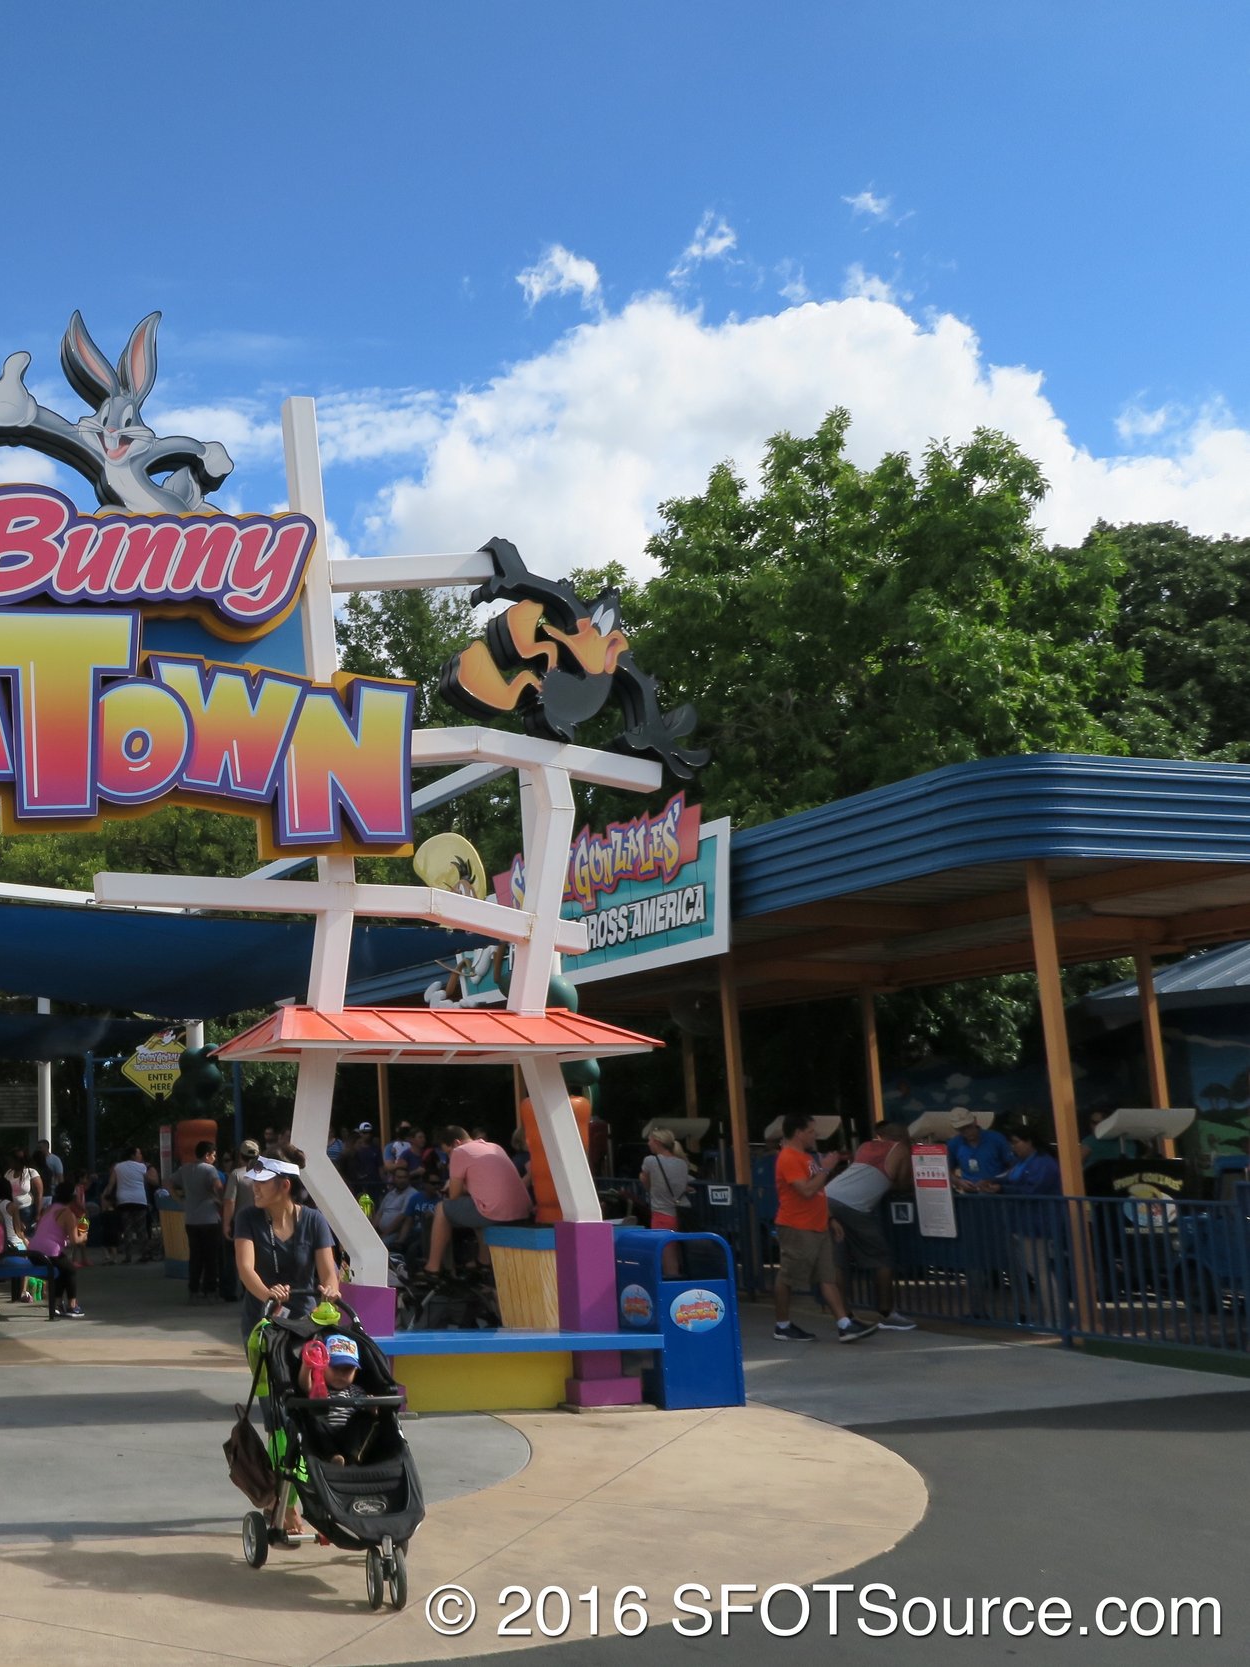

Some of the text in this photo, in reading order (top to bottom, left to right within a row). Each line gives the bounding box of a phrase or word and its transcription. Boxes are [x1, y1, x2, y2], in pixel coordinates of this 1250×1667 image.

[629, 883, 706, 939] AMERICA
[147, 1073, 174, 1081] ENTER
[150, 1082, 171, 1091] HERE
